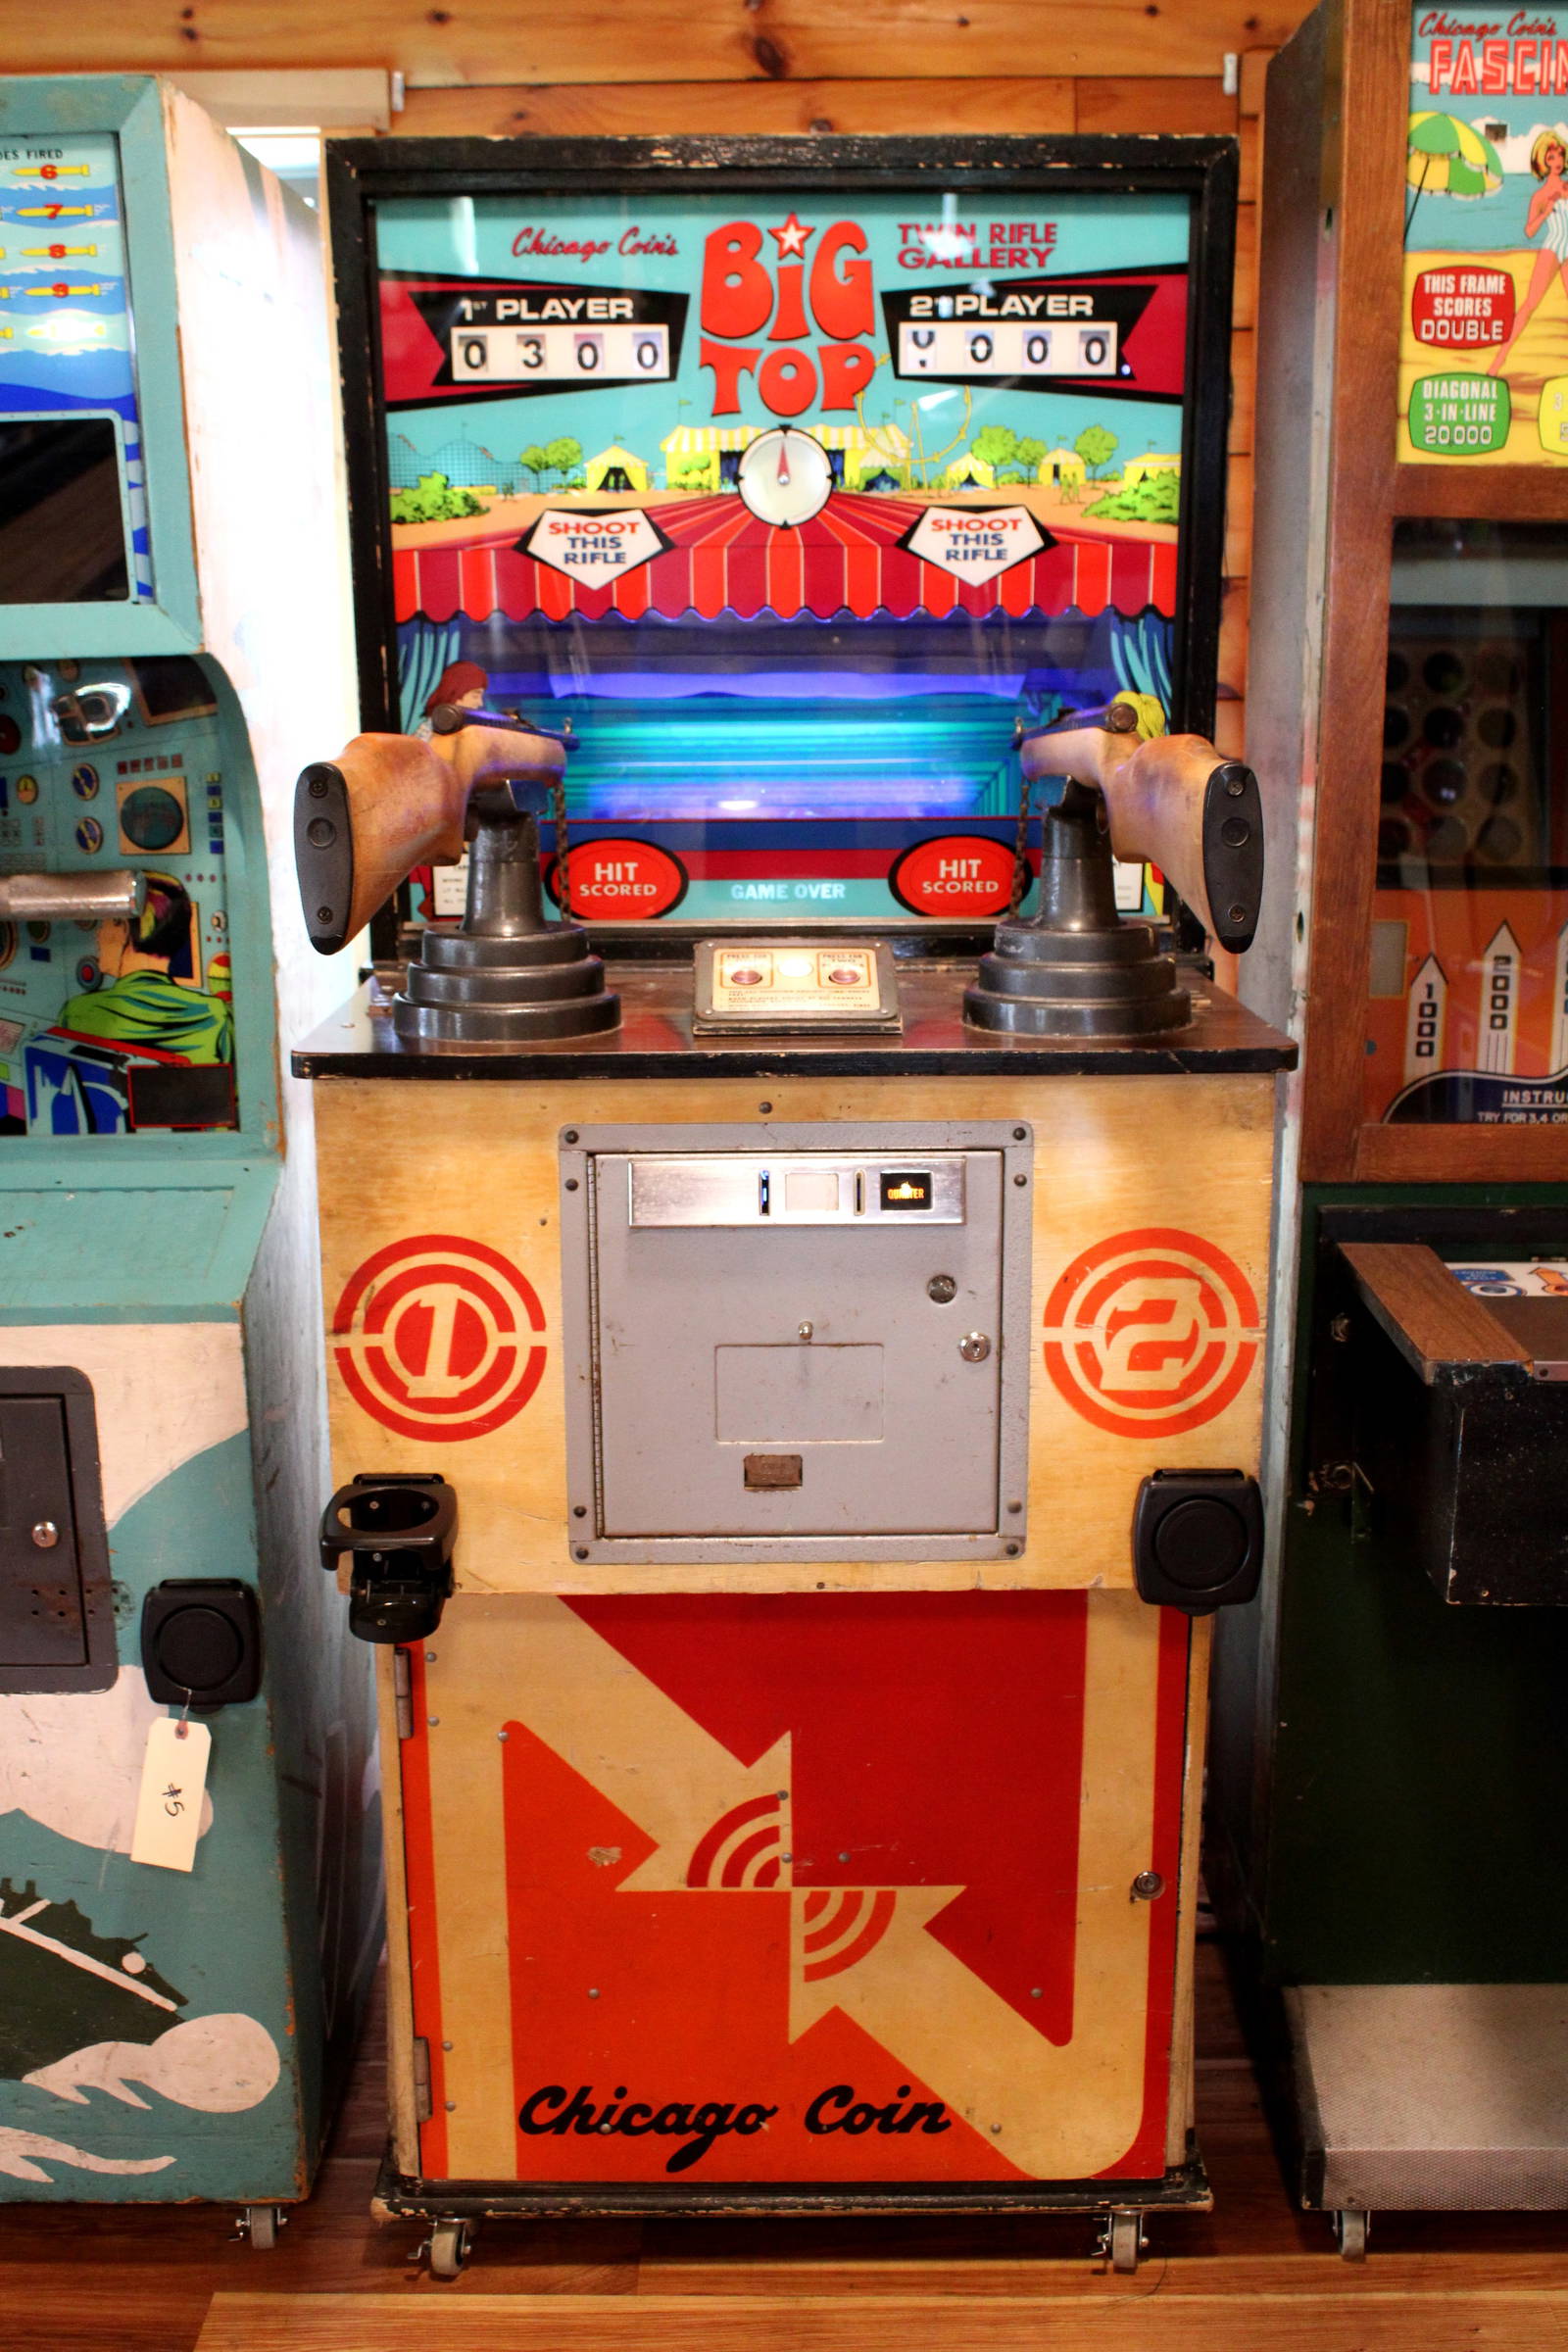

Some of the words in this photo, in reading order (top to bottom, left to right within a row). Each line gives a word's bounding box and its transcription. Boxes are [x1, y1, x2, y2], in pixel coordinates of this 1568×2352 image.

[1419, 12, 1502, 41] Chicago
[1507, 12, 1557, 36] Coin's
[26, 149, 64, 160] FIRED
[40, 165, 58, 179] 6
[44, 203, 64, 220] 7
[990, 222, 1057, 244] RIFLE
[512, 226, 612, 262] Chicago
[618, 226, 679, 257] Coin's
[897, 247, 1054, 269] GALLERY
[1424, 274, 1455, 294] THIS
[1460, 274, 1505, 294] FRAME
[496, 298, 634, 320] PLAYER
[956, 295, 1094, 317] PLAYER
[1434, 297, 1493, 317] SCORES
[1421, 319, 1504, 341] DOUBLE
[700, 338, 876, 416] TOP
[1423, 380, 1497, 400] DIAGONAL
[549, 518, 640, 535] SHOOT
[931, 515, 1021, 532] SHOOT
[566, 536, 622, 550] THIS
[949, 533, 1004, 547] THIS
[564, 551, 627, 564] RIFLE
[945, 548, 1008, 562] RIFLE
[595, 861, 639, 882] HIT
[939, 858, 982, 879] HIT
[579, 883, 658, 898] SCORED
[731, 884, 789, 900] GAME
[793, 883, 847, 900] OVER
[921, 880, 1000, 895] SCORED
[1503, 1090, 1568, 1103] INSTRU
[1477, 1111, 1501, 1123] TRY
[1503, 1111, 1527, 1123] FOR
[1100, 1277, 1202, 1391] 2
[517, 2084, 779, 2174] Chicago
[804, 2084, 952, 2134] Coin
